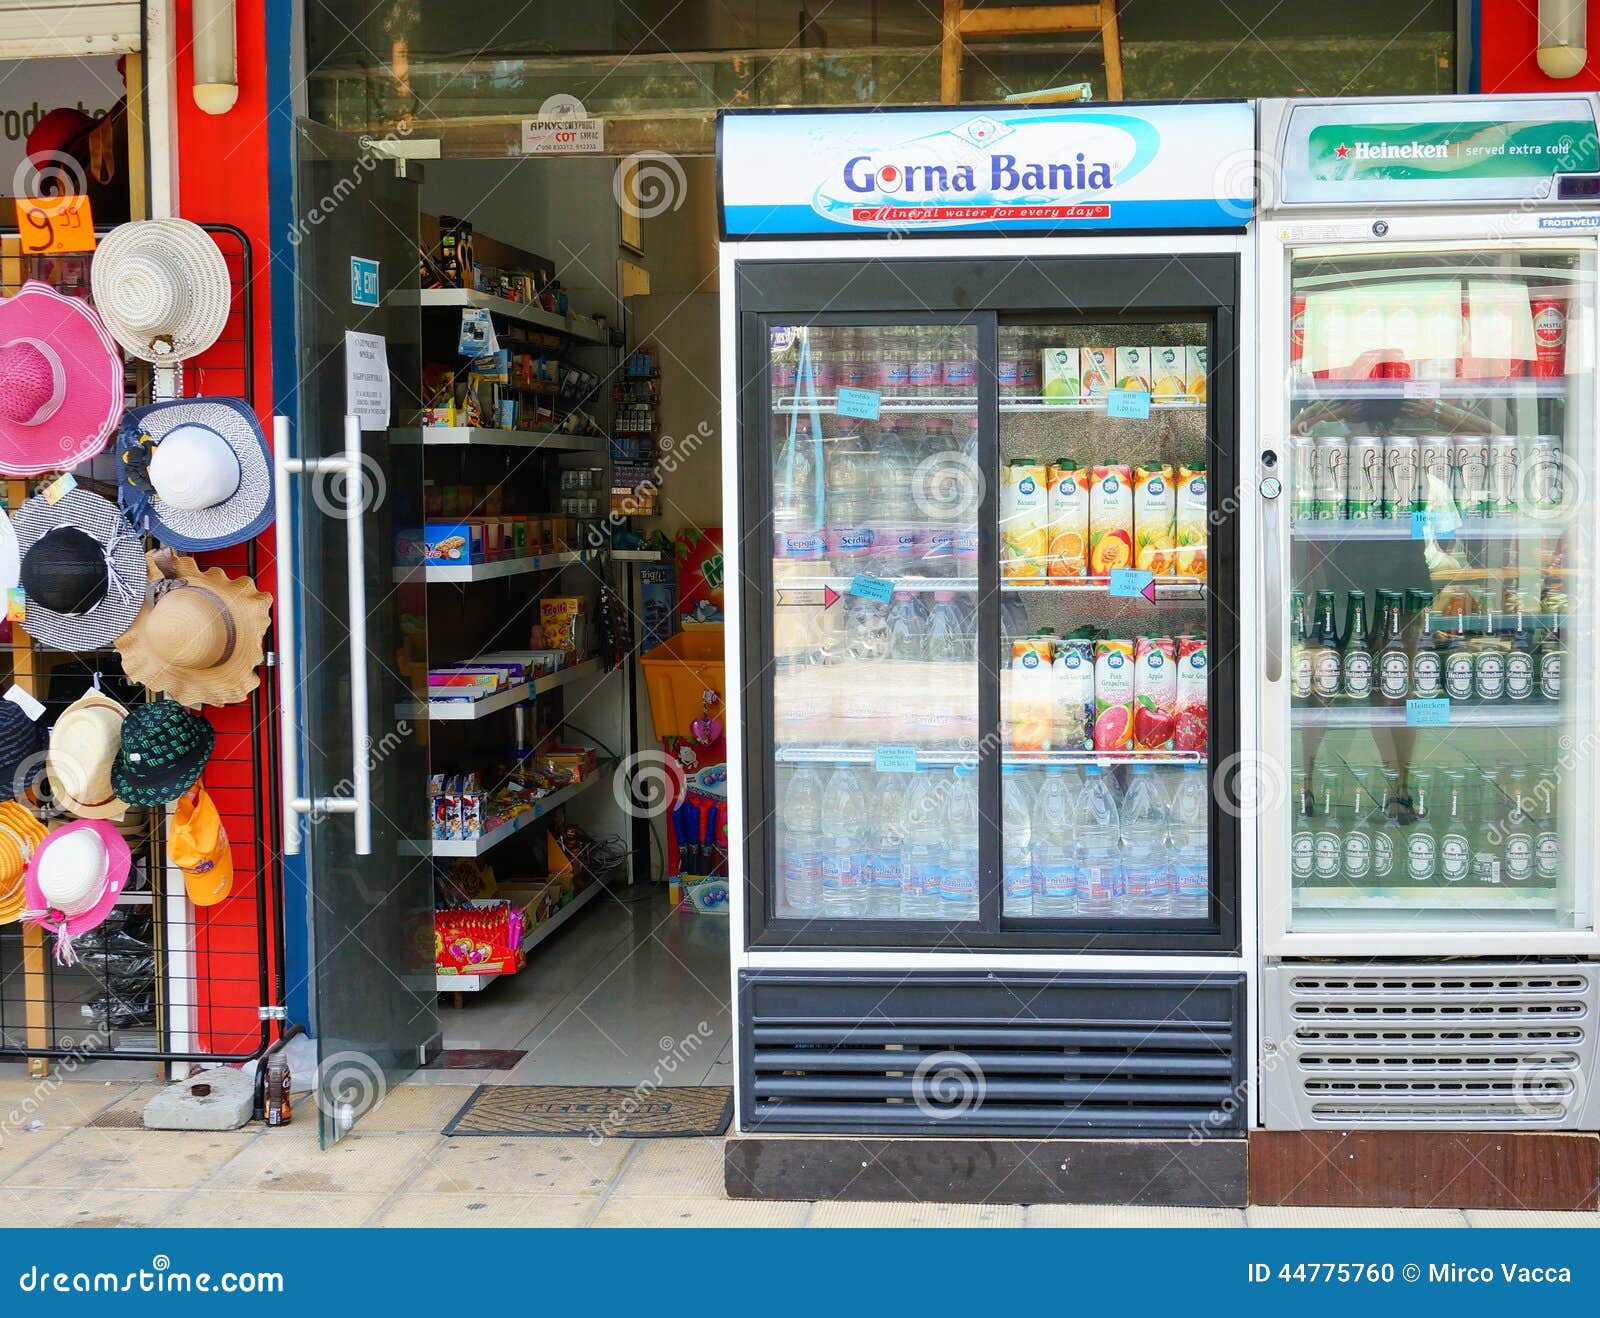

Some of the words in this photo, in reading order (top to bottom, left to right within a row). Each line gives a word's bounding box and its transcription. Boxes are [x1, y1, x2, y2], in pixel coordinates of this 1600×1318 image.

[1355, 141, 1448, 159] Heineken
[1465, 143, 1505, 155] served
[1509, 144, 1542, 155] extra
[1545, 142, 1570, 155] cold
[843, 156, 977, 194] Gorna
[990, 152, 1115, 192] Bania
[857, 203, 939, 222] Mineral
[950, 207, 988, 218] water
[989, 207, 1015, 219] for
[1020, 207, 1059, 219] every
[363, 271, 377, 296] EXIT
[1148, 672, 1164, 681] Apple
